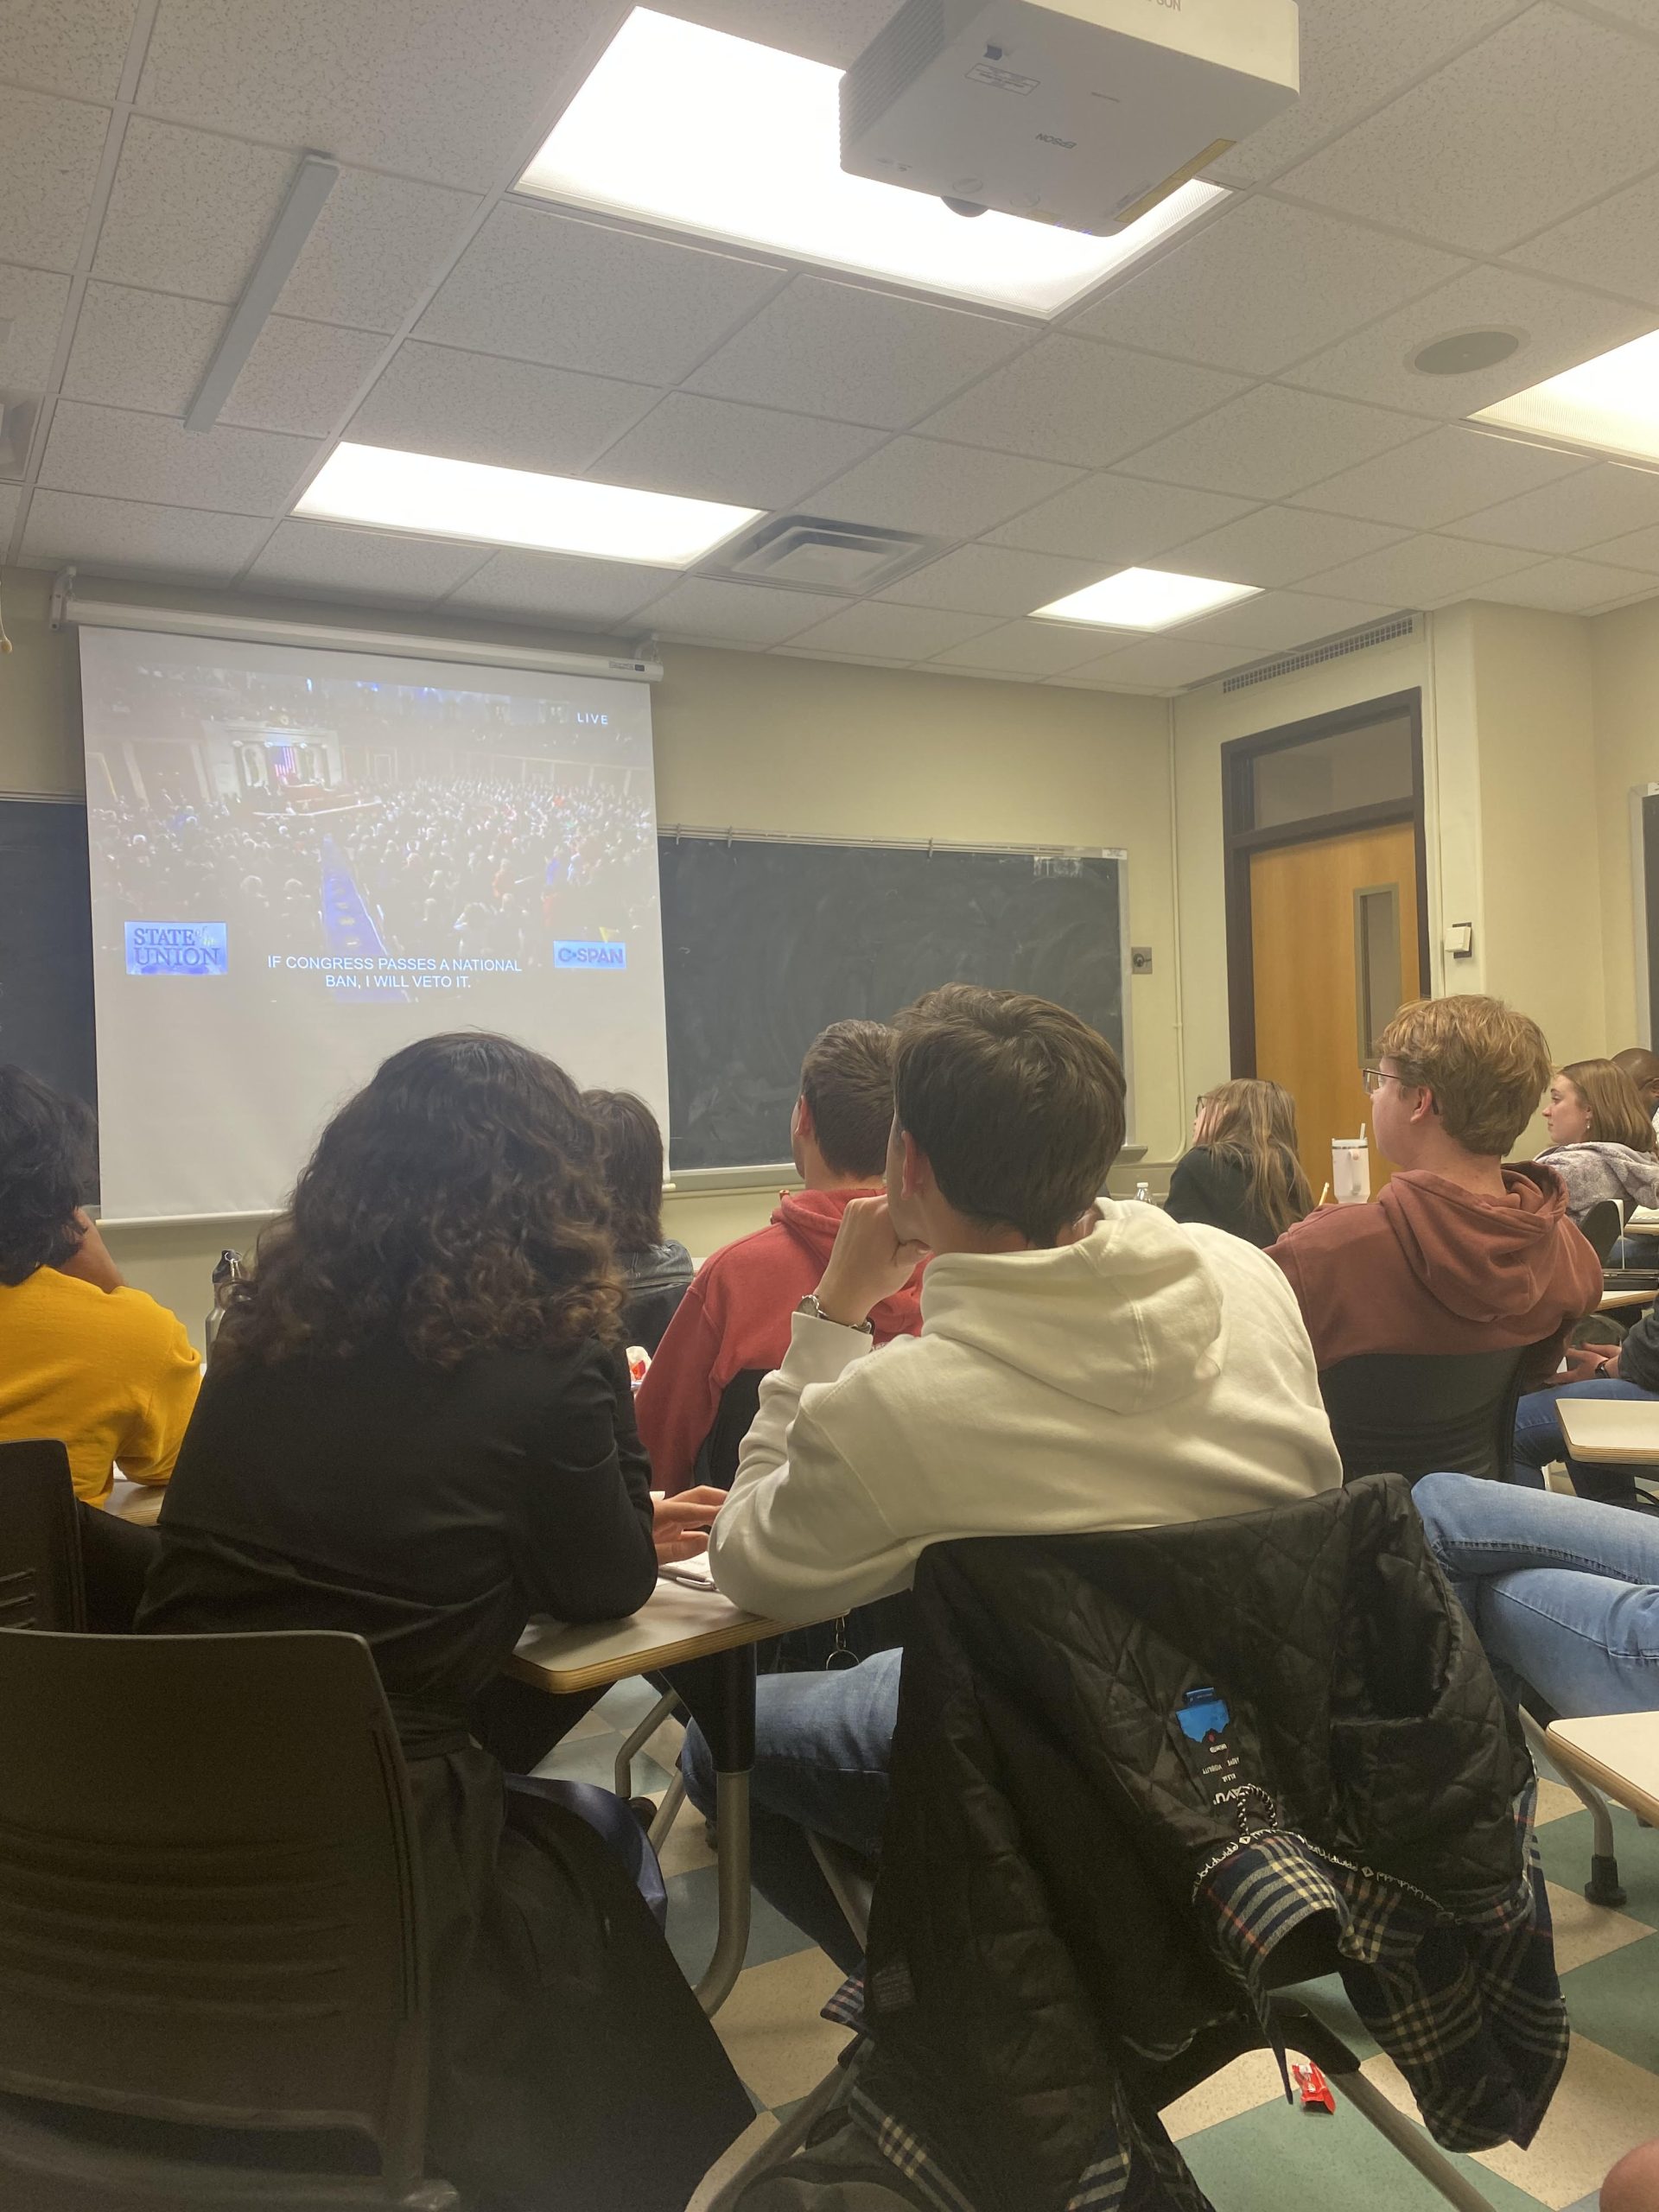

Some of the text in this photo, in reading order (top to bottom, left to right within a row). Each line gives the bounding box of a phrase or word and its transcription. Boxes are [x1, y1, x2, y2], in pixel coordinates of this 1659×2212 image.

[1035, 132, 1077, 149] EPSON
[576, 712, 608, 726] LIVE
[134, 927, 195, 946] STATE
[133, 947, 220, 966] UNION
[267, 955, 523, 972] IF CONGRESS PASSES A NATIONAL
[325, 975, 361, 989] BAN,
[373, 975, 410, 988] WILL
[411, 976, 452, 988] VETO
[455, 976, 472, 988] IT.
